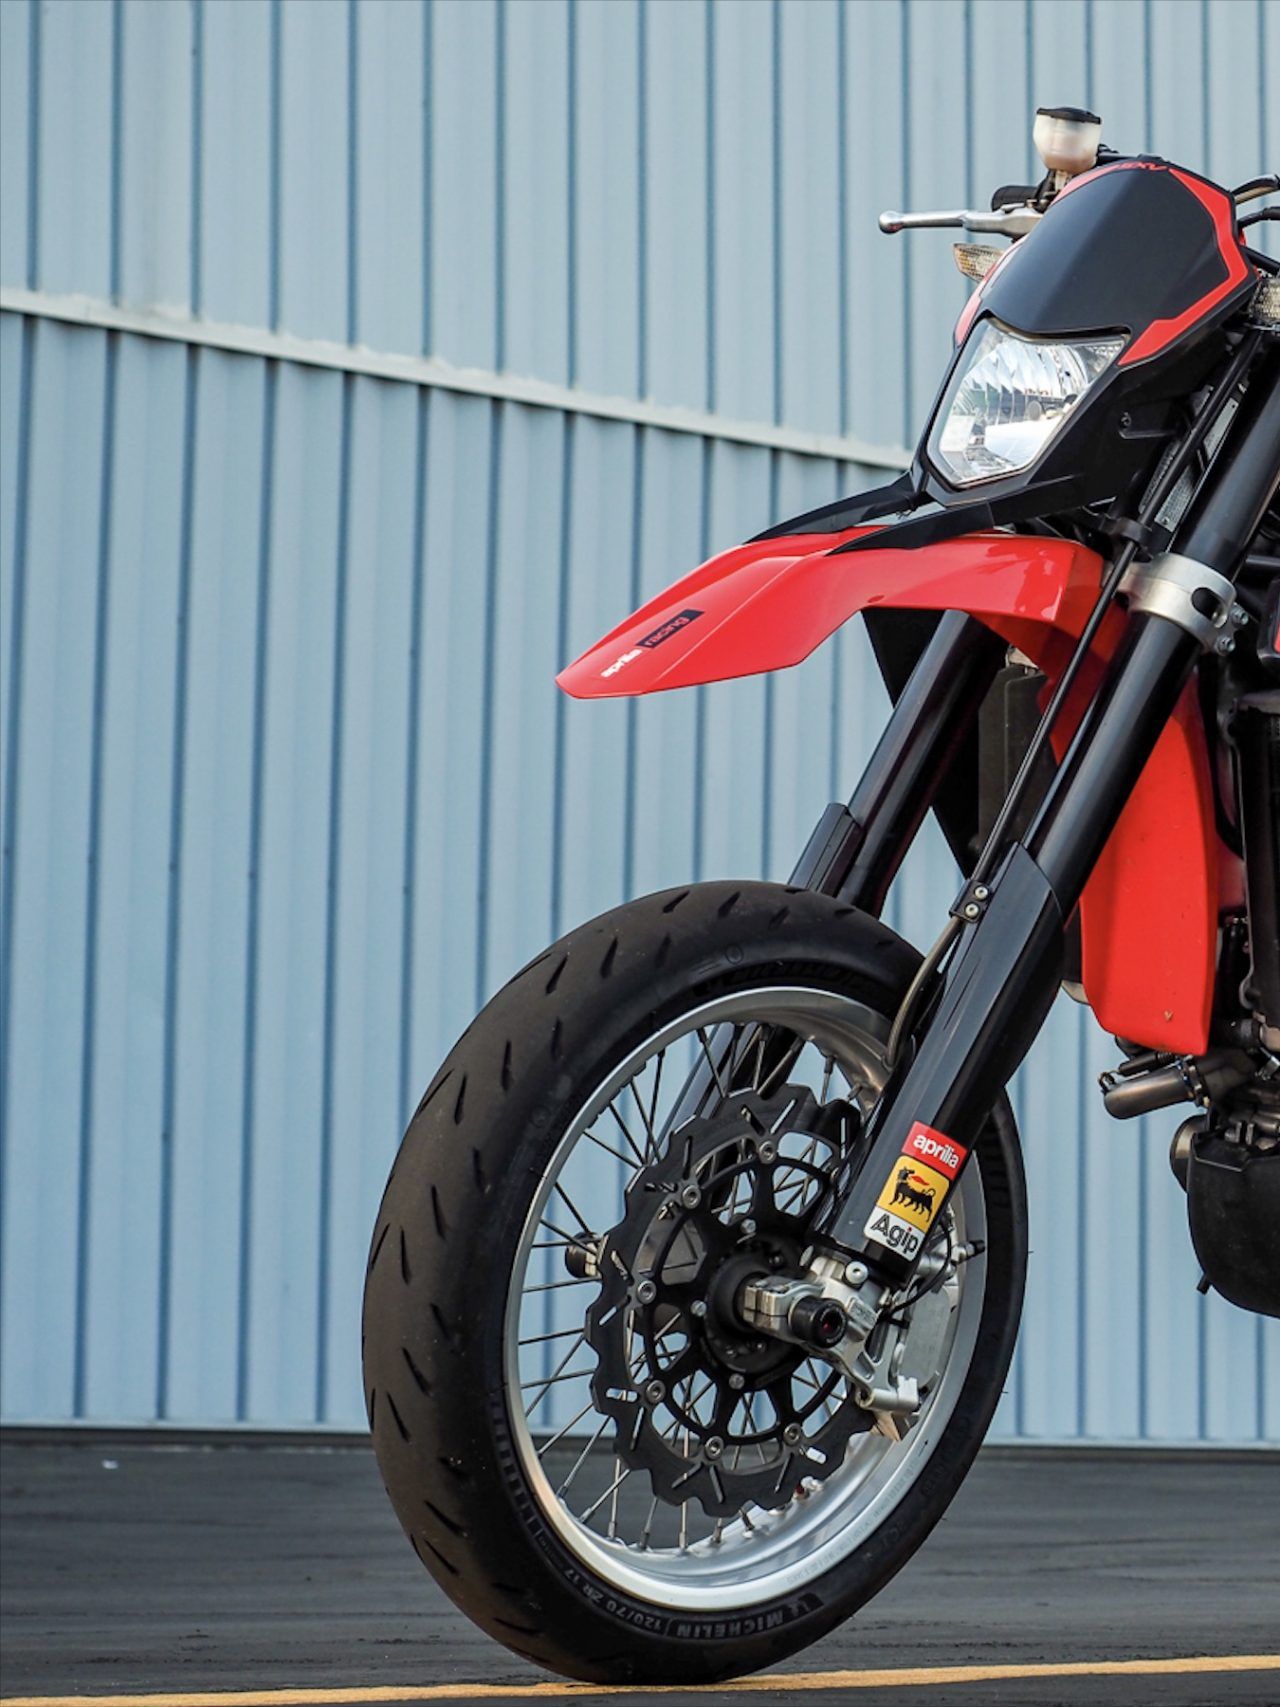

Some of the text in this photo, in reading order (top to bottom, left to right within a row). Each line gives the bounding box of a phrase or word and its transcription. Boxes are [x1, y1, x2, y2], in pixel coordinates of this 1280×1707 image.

[913, 1134, 959, 1169] aprilia
[870, 1213, 919, 1254] Agip
[606, 1602, 662, 1631] 120/70
[677, 1611, 784, 1639] MICHELIN
